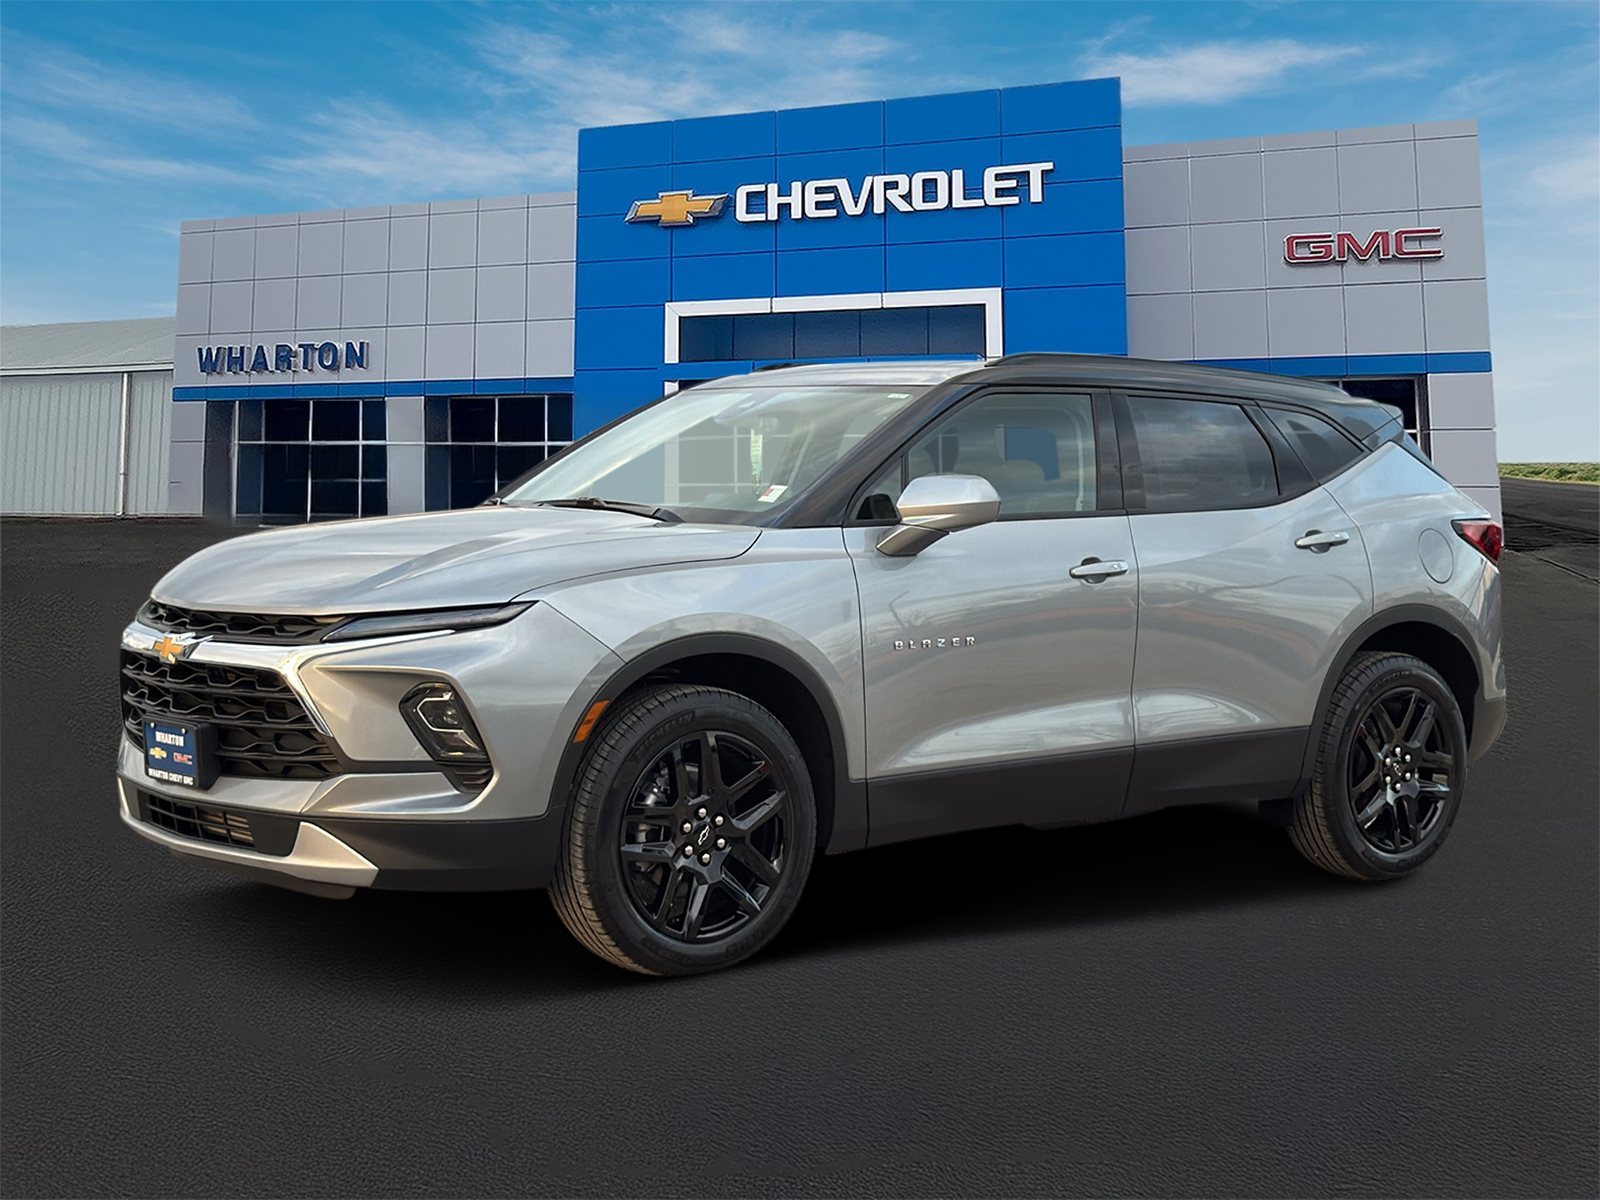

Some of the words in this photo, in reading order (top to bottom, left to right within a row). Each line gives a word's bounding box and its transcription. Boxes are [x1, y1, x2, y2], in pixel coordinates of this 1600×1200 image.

[734, 162, 1054, 222] CHEVROLET
[1284, 227, 1444, 264] GMC
[197, 341, 369, 374] WHARTON
[894, 636, 975, 650] BLAZER
[155, 731, 184, 747] WHARTON
[173, 752, 193, 765] GMC
